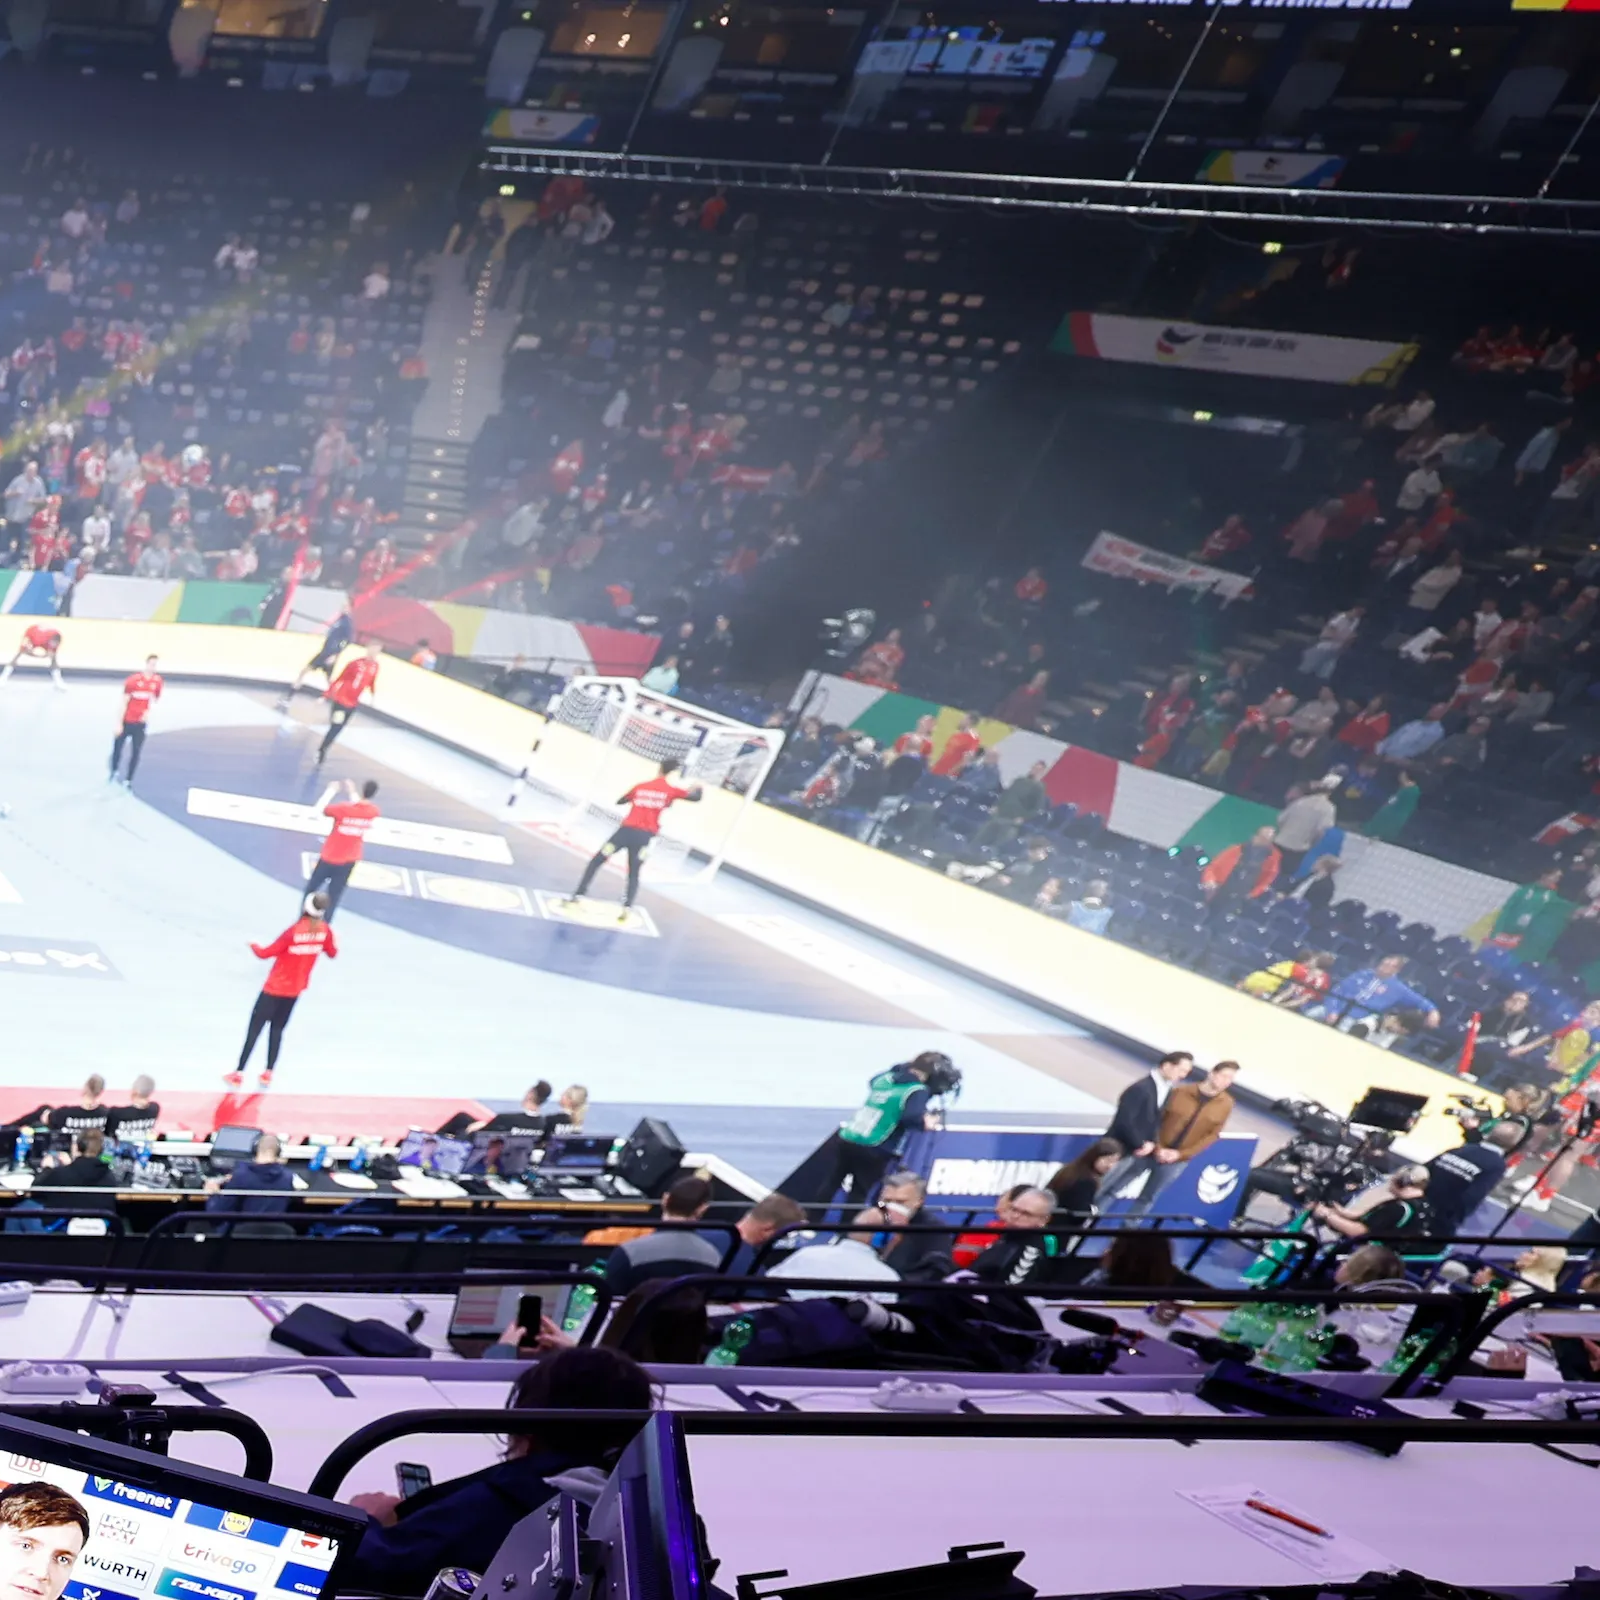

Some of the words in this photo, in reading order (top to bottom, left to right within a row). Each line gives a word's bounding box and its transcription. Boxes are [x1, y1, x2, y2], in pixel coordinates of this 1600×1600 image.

[112, 1482, 174, 1512] freenet
[83, 1554, 148, 1583] WÜRTH
[183, 1543, 257, 1575] trivago
